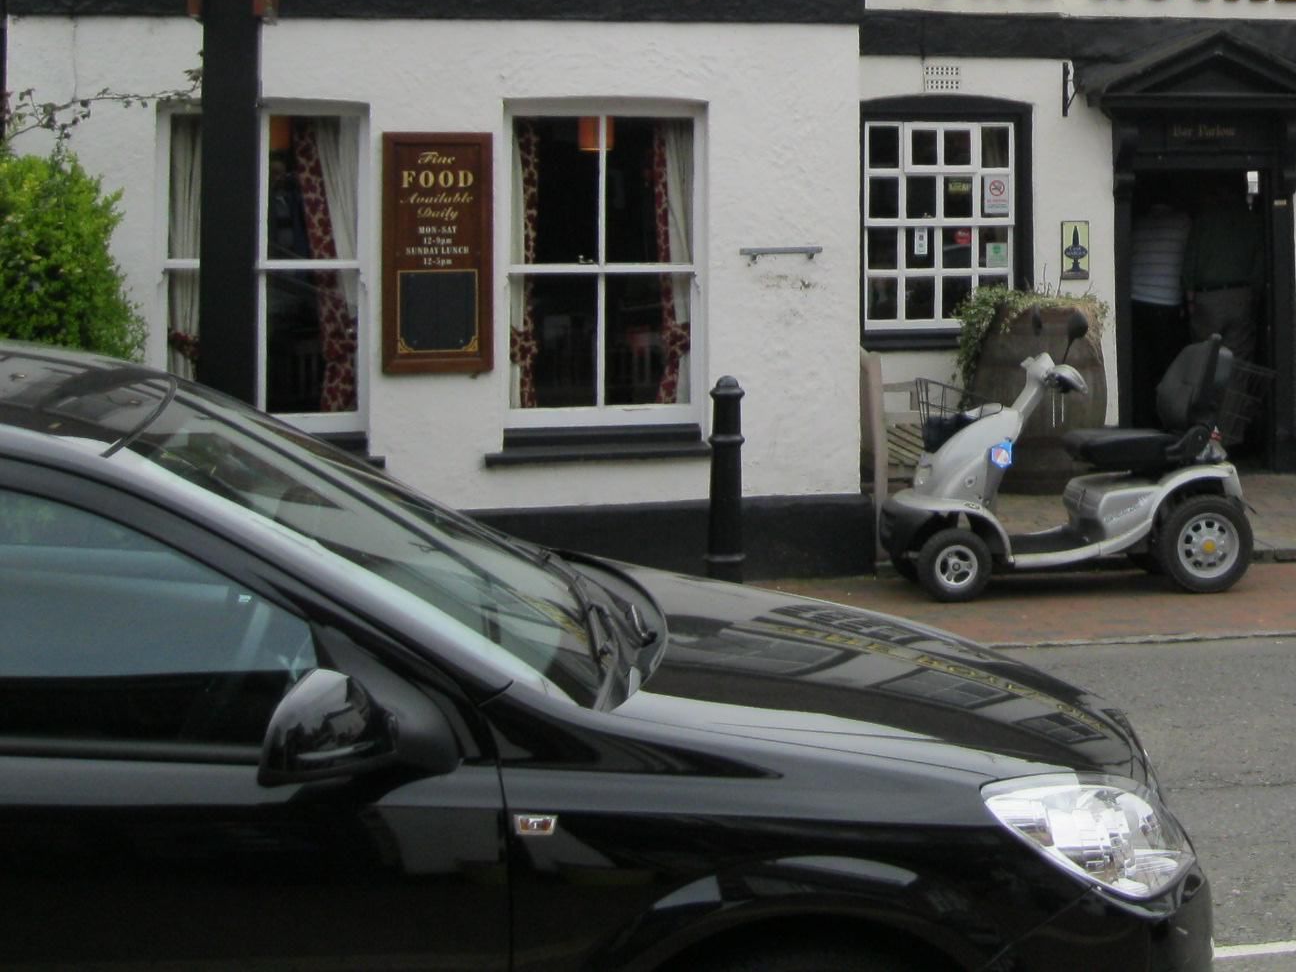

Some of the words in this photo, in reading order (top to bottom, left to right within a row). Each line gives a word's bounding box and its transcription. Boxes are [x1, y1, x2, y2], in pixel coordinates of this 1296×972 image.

[418, 151, 456, 165] Fine
[401, 170, 475, 188] FOOD
[400, 192, 473, 204] Available
[416, 207, 459, 221] Daily
[405, 246, 440, 255] SUNDAY
[441, 246, 469, 254] LUNCH
